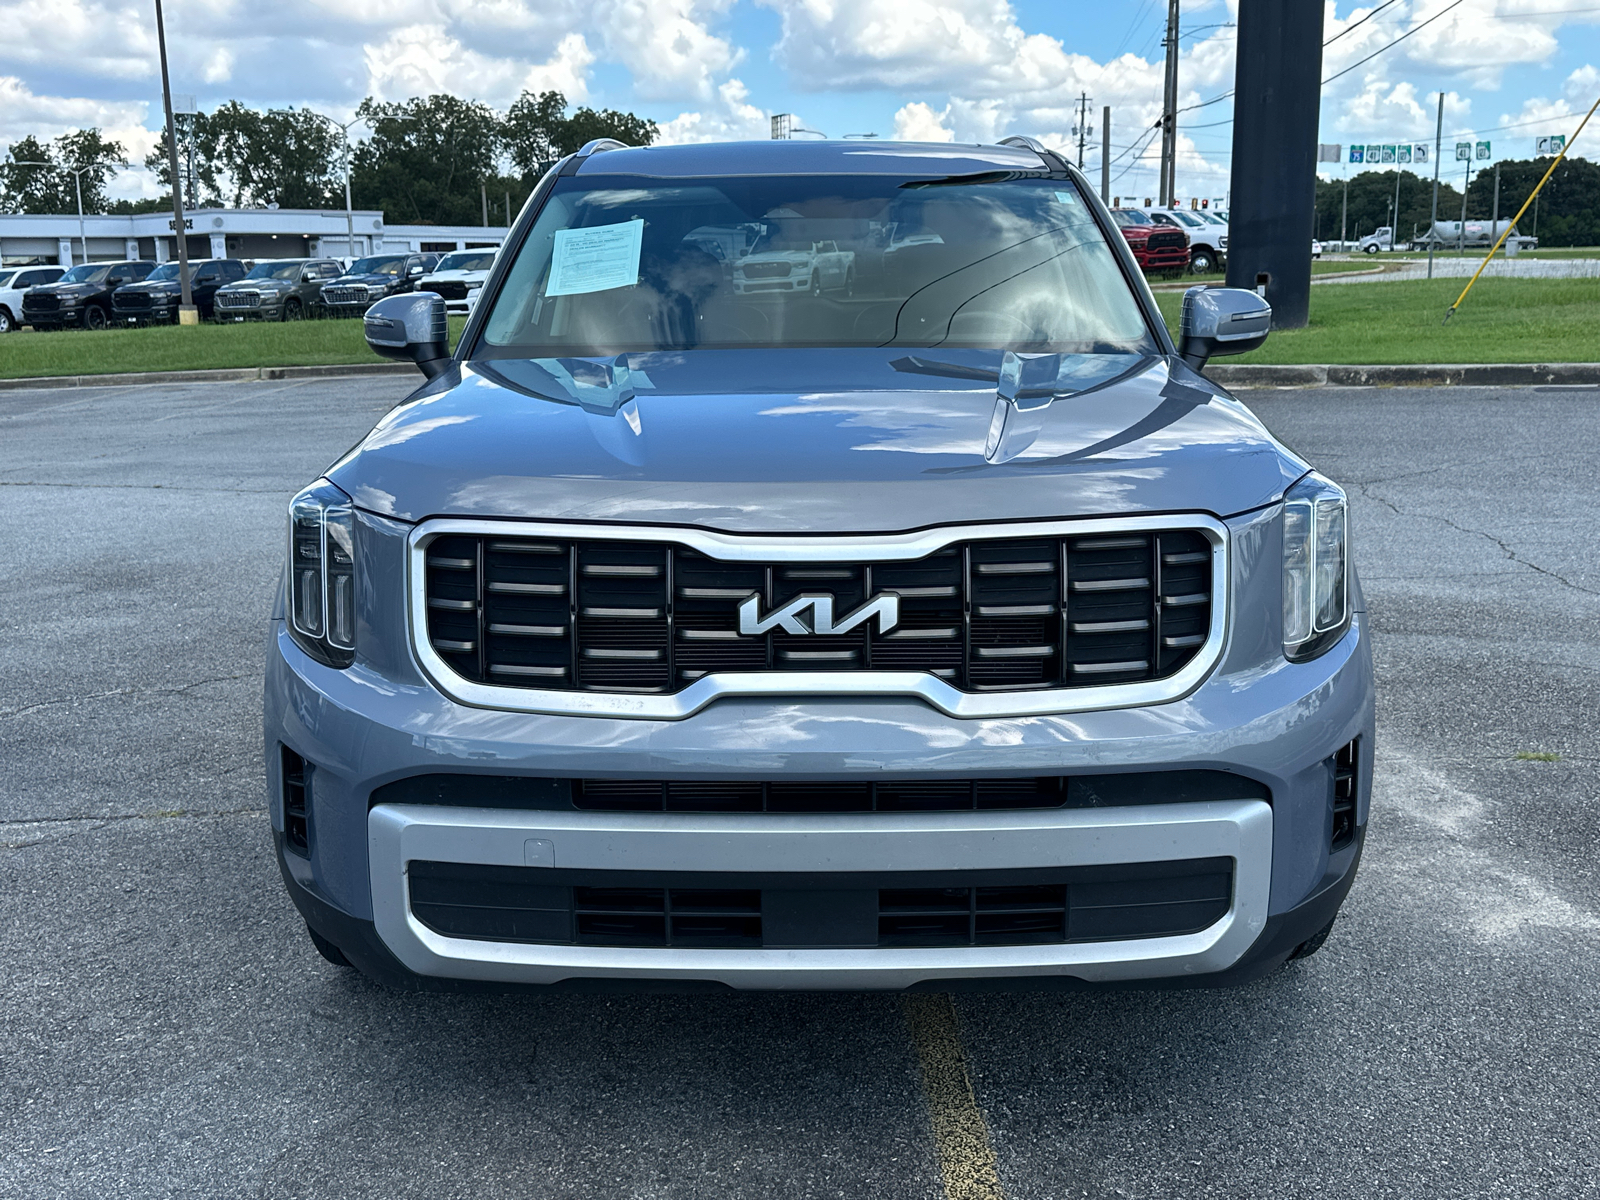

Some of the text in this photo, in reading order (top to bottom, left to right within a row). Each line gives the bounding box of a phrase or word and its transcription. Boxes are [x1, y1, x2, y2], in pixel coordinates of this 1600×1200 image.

[1353, 152, 1361, 161] 75
[1369, 152, 1377, 160] 41
[1459, 149, 1467, 158] 41
[738, 592, 901, 635] KIA
